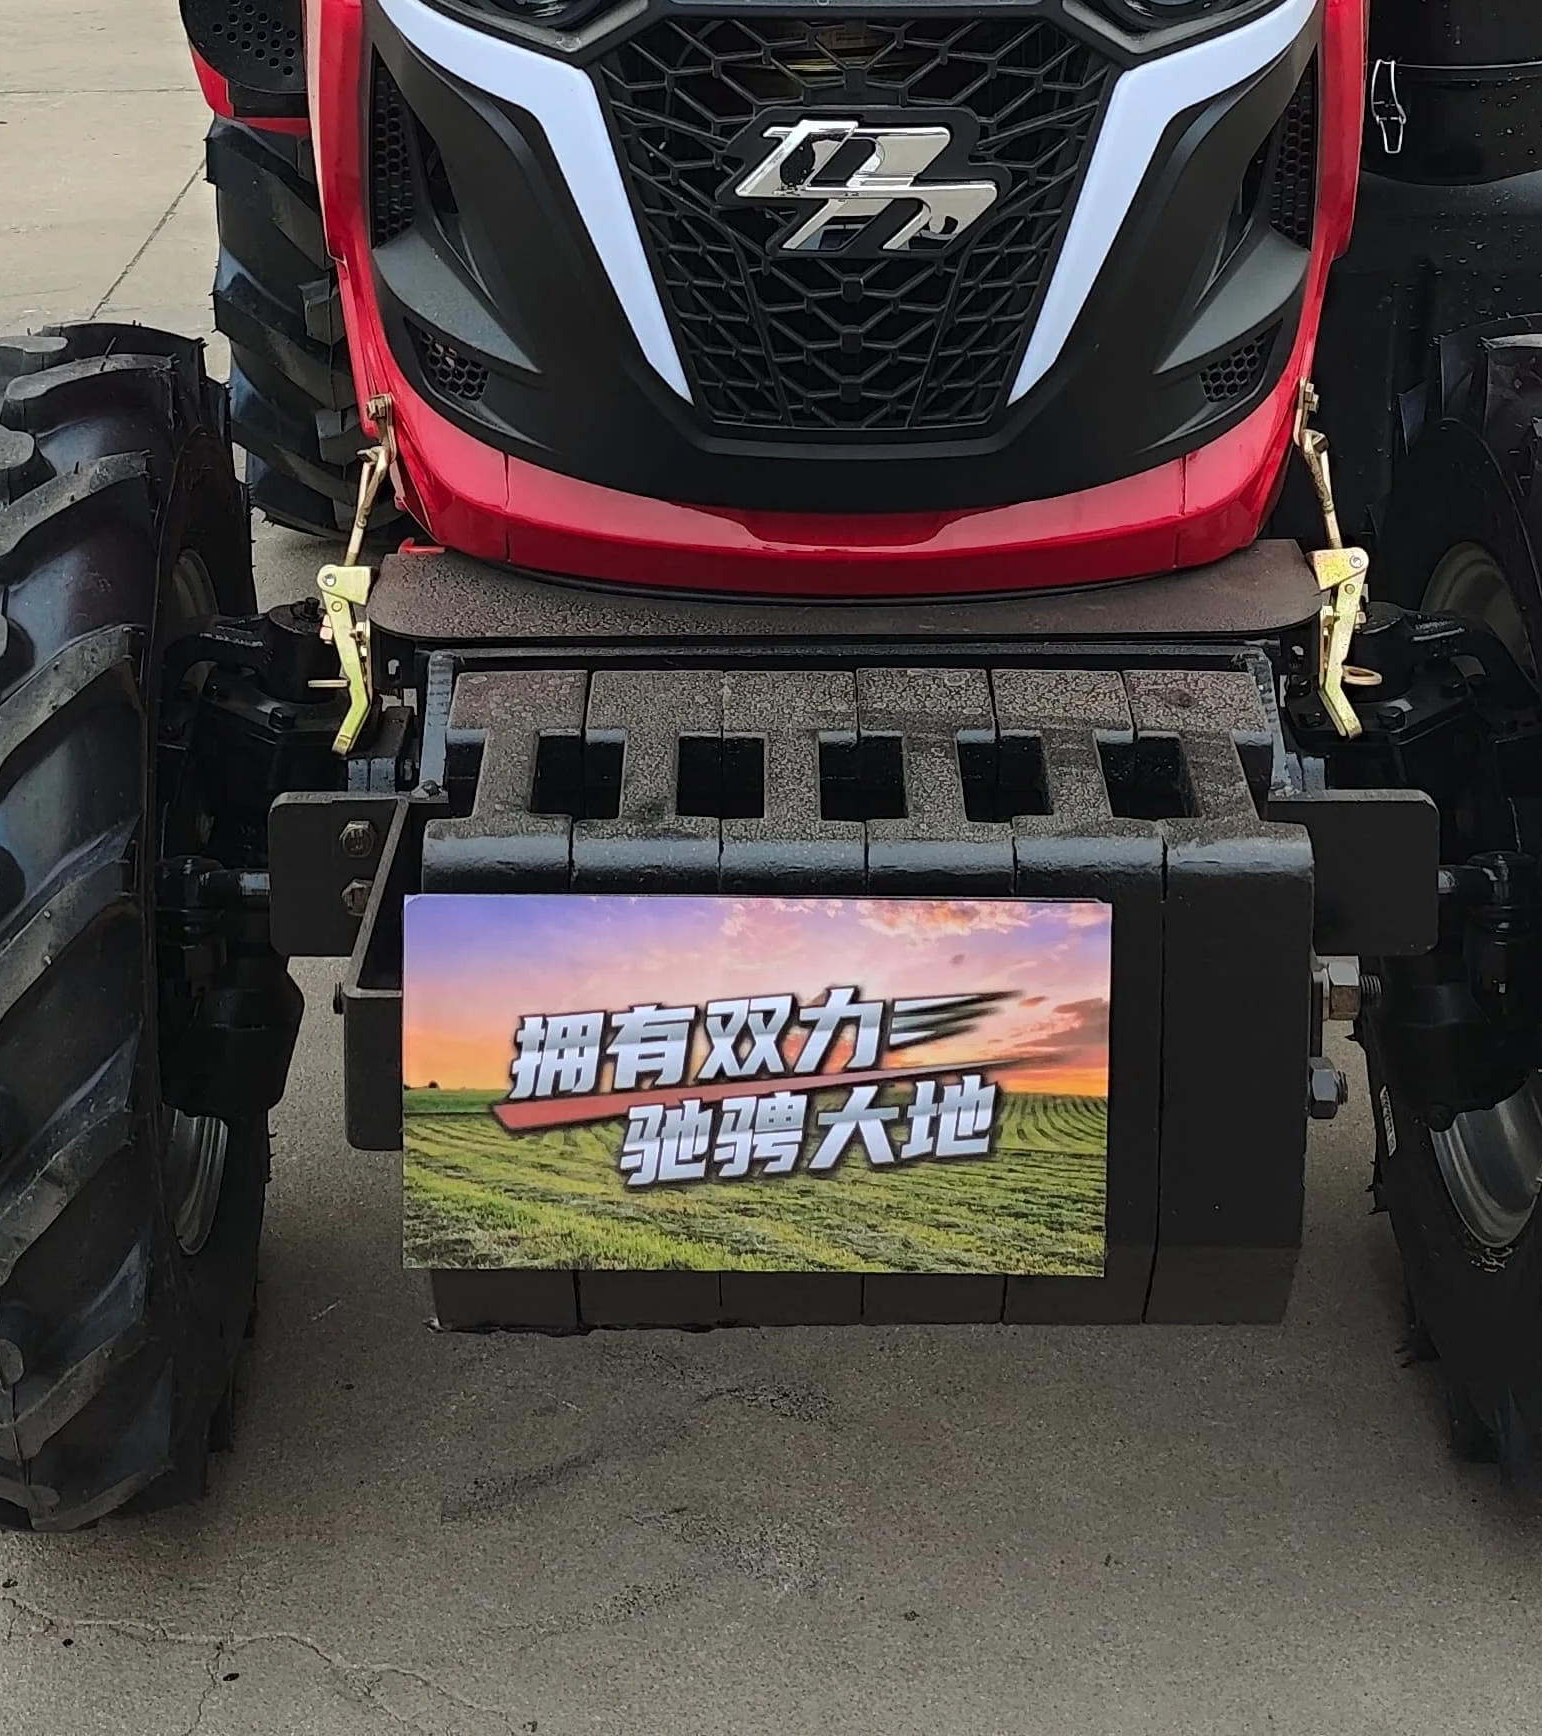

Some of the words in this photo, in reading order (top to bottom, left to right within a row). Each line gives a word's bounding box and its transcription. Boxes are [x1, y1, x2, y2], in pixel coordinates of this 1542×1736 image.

[509, 986, 886, 1099] 拥有双力
[618, 1075, 998, 1186] 驰骋大地
